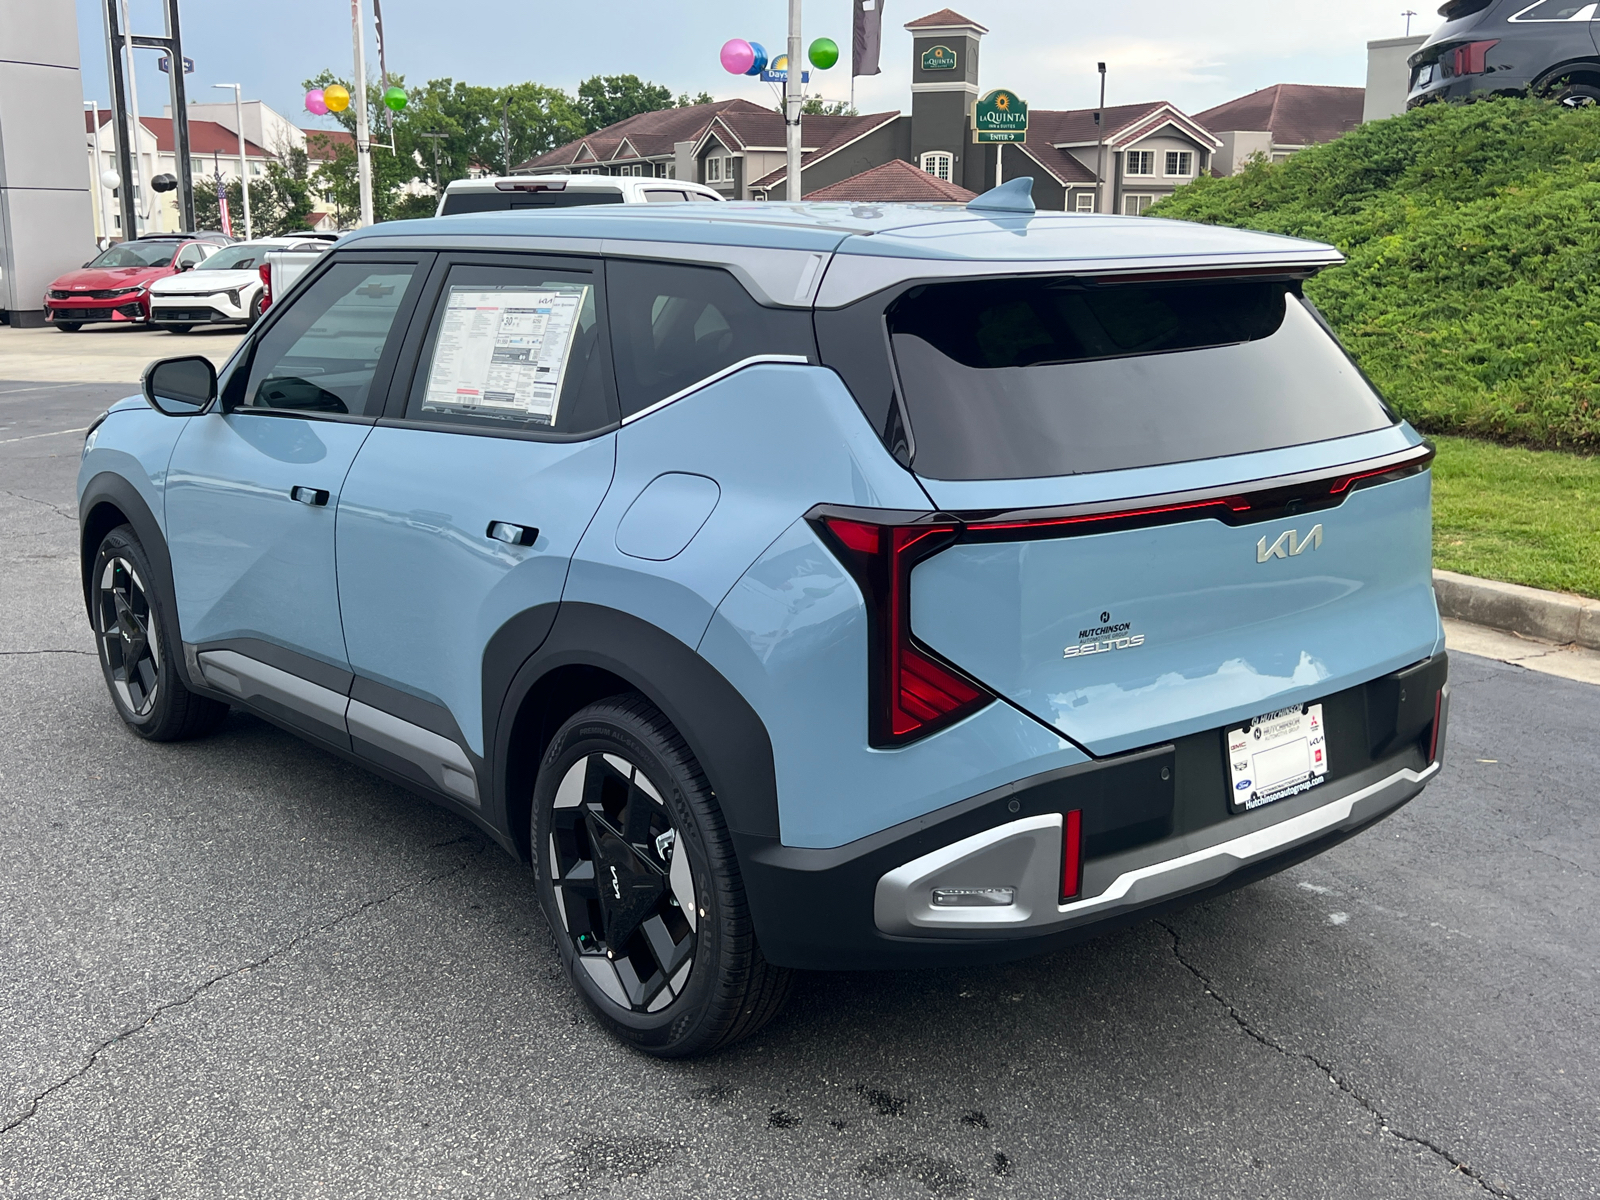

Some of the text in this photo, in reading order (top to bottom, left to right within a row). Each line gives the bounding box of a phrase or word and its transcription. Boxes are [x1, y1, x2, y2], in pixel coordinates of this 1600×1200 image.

[929, 58, 954, 66] QUINTA
[987, 111, 1026, 124] QUINTA
[1256, 523, 1323, 564] KIA
[1078, 622, 1132, 639] HUTCHINSON
[1079, 630, 1129, 644] AUTOMOTIVE GROUP
[1063, 634, 1145, 659] SELTOS
[579, 726, 612, 736] PREMIUM
[1230, 741, 1247, 750] GMC
[1310, 736, 1324, 746] KIA
[1245, 775, 1325, 811] Hutchinsonautogroup.com
[530, 797, 541, 881] KUMHO
[698, 872, 712, 966] SOLUS
